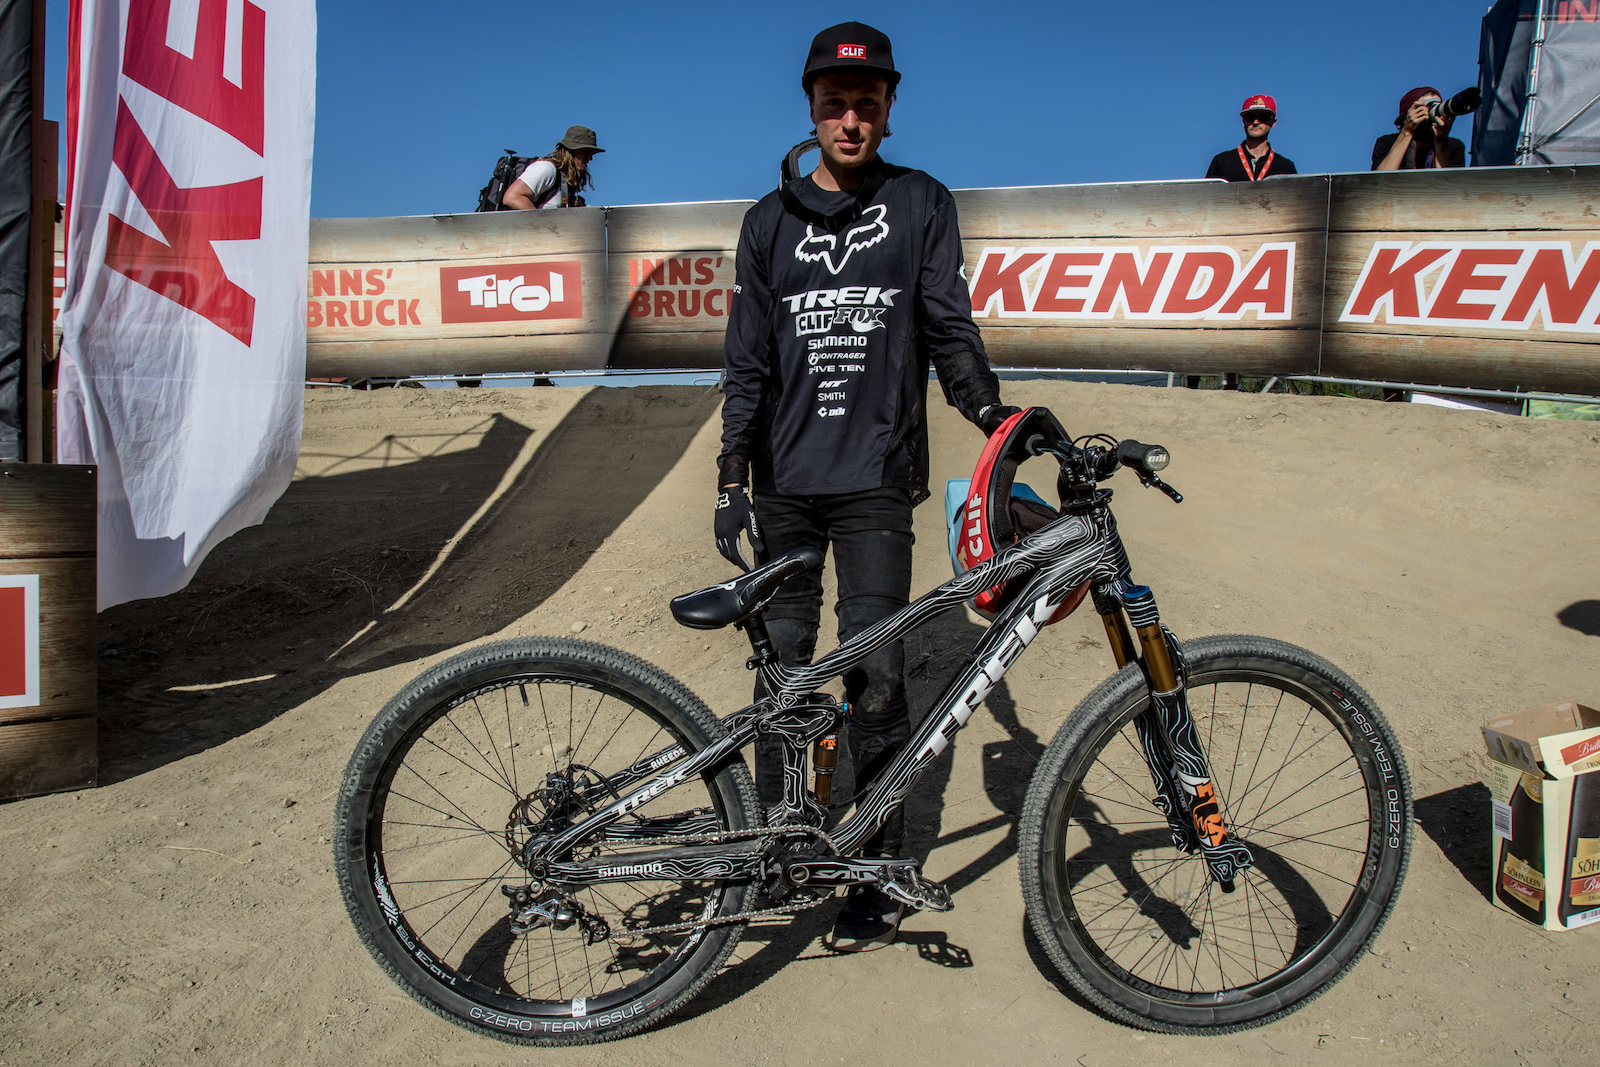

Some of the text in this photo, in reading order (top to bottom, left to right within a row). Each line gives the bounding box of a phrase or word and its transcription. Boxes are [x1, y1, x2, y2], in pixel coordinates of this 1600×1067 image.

[1557, 0, 1600, 25] IN
[841, 47, 864, 57] CLIF
[308, 267, 394, 297] NNS'
[629, 257, 724, 286] INNS'
[971, 244, 1296, 318] KENDA
[457, 271, 564, 312] Tirol
[782, 286, 902, 314] TREK
[306, 298, 422, 328] BRUCK
[798, 312, 834, 333] CLIF
[833, 307, 886, 329] FOX
[808, 336, 868, 350] SHMANO
[818, 352, 867, 361] ONTRAGER
[838, 364, 866, 373] TEN
[818, 392, 846, 402] SMITH
[968, 492, 985, 558] CLIF
[915, 593, 1061, 762] TREK
[1338, 697, 1376, 738] ISSUE
[1369, 737, 1395, 783] TEAM
[611, 768, 688, 816] TREK
[597, 862, 663, 879] SHIMANO
[469, 1002, 646, 1033] G-ZERO TEAM ISSUE
